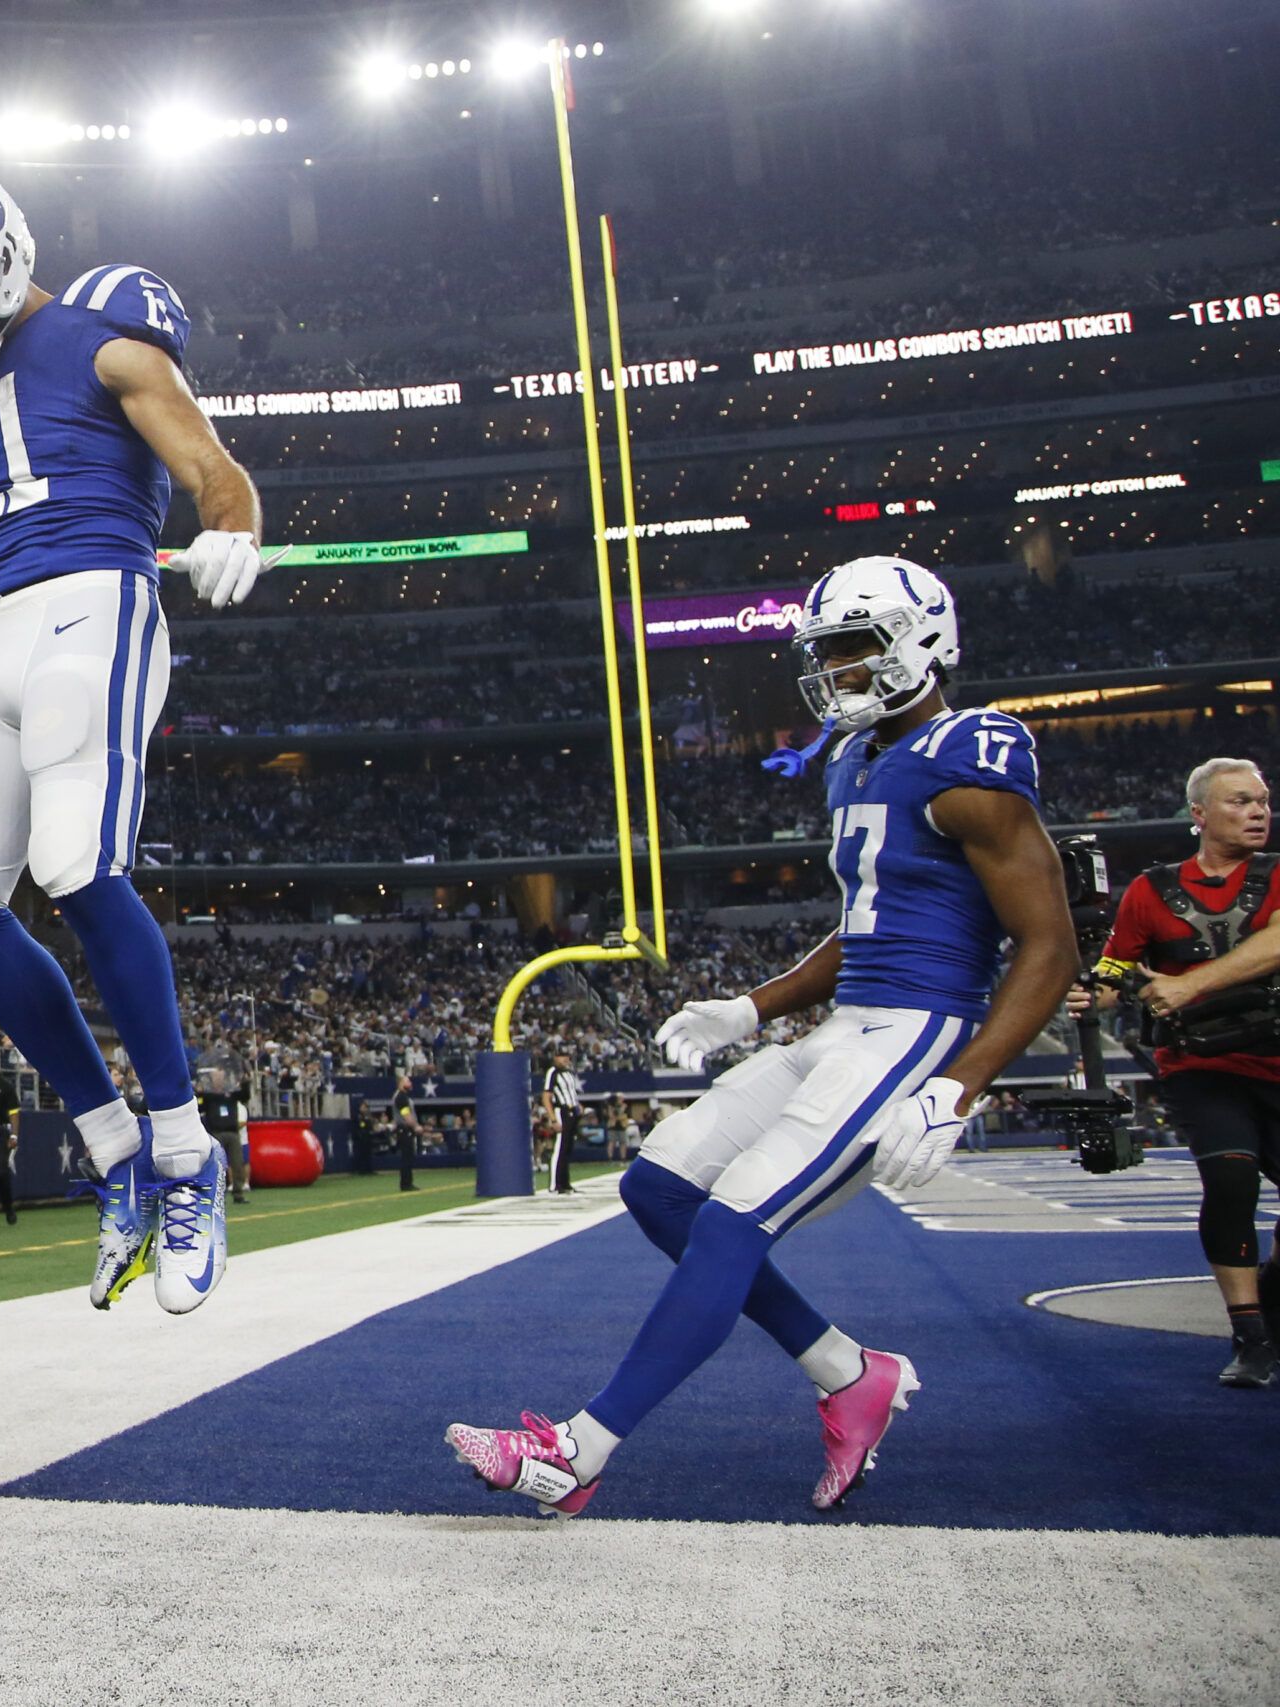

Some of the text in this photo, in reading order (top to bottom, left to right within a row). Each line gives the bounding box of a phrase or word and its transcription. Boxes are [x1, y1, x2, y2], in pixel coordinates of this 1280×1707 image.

[143, 289, 175, 335] 11
[1188, 291, 1280, 326] TEXAS
[753, 312, 1132, 375] PLAY THE DALLAS COWBOYS SCRATCH TICKET!
[257, 392, 330, 416] COWBOYS
[331, 388, 400, 413] SCRATCH
[400, 383, 461, 409] TICKET!
[1014, 485, 1071, 502] JANUARY
[1091, 478, 1145, 495] COTTON
[1146, 474, 1186, 490] BOWL
[315, 547, 363, 559] JANUARY
[381, 545, 425, 557] COTTON
[429, 541, 461, 553] BOWL
[974, 731, 1016, 774] 17
[830, 804, 888, 934] 17
[530, 1485, 554, 1499] Society
[533, 1479, 556, 1492] Cancer
[535, 1472, 568, 1490] American
